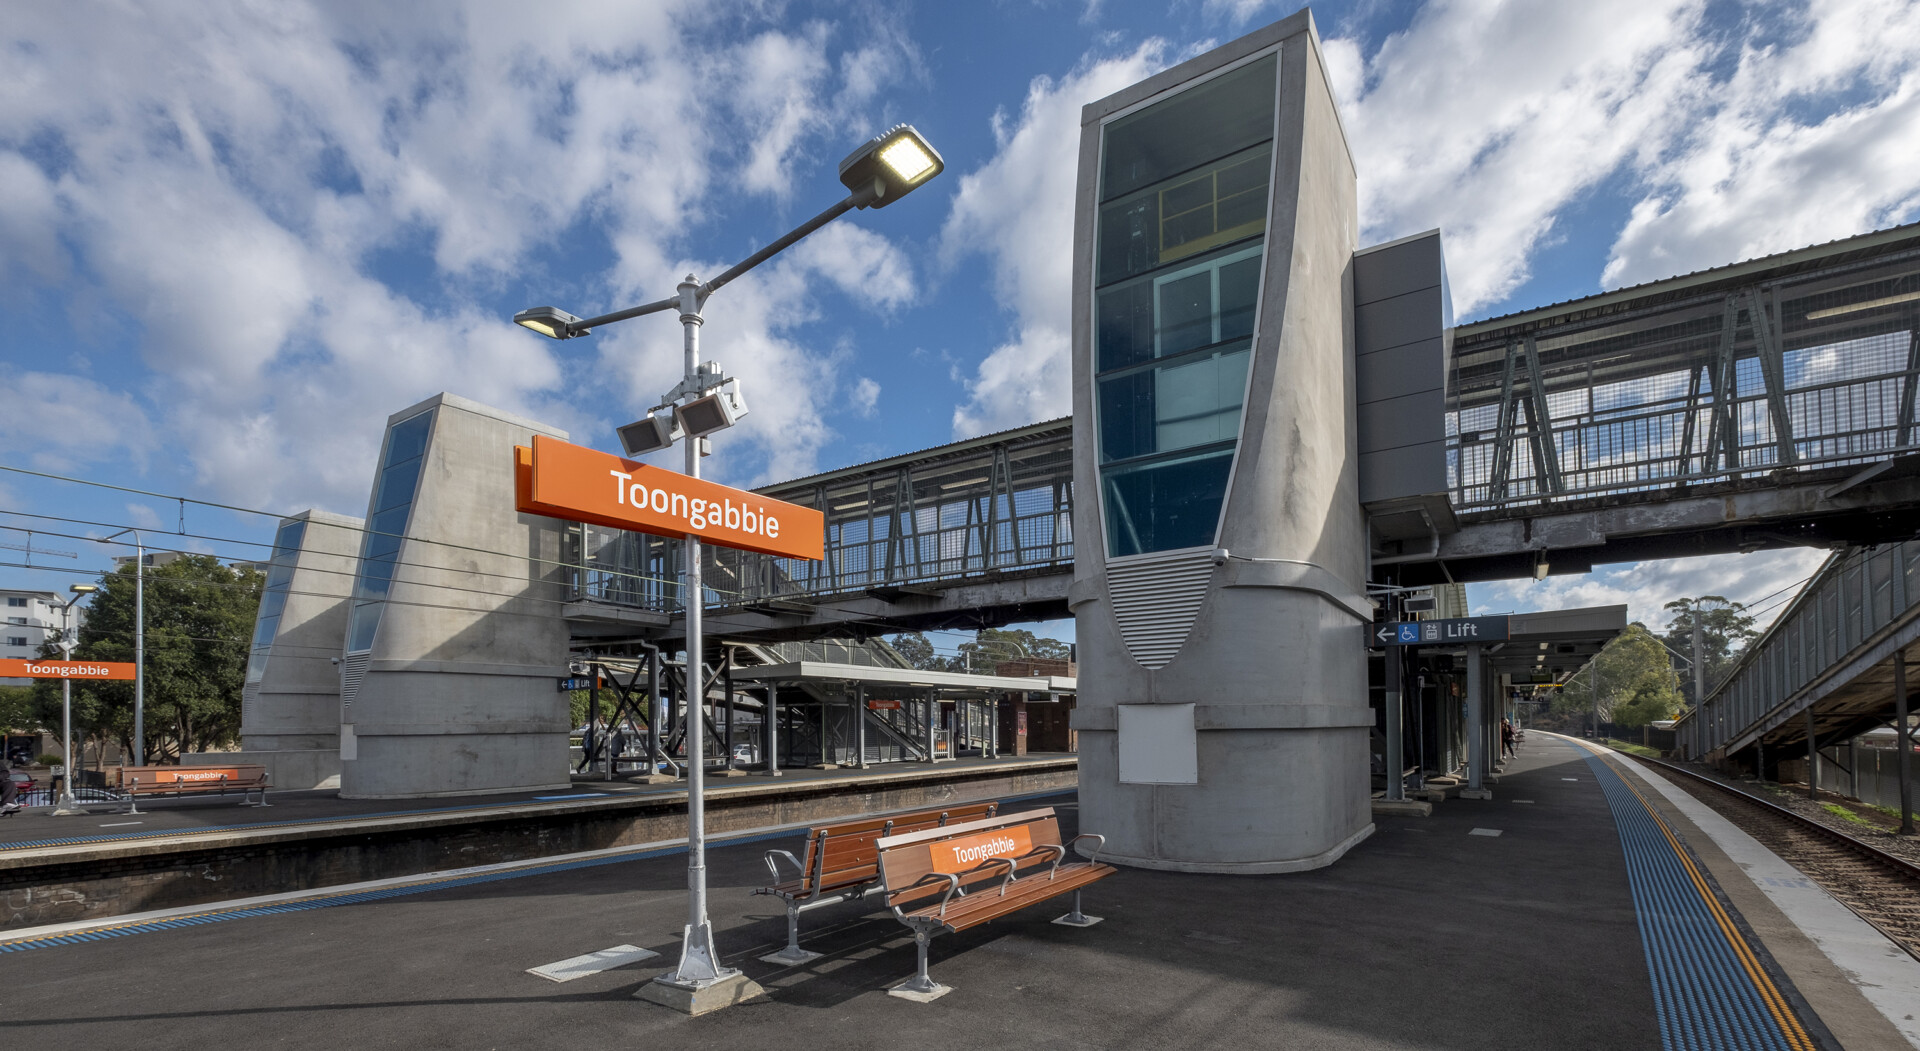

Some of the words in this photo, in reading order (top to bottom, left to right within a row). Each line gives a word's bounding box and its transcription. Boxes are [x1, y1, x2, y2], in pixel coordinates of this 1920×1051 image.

[610, 470, 779, 538] Toongabbie
[1448, 624, 1477, 637] Lift
[24, 663, 109, 677] Toongabbie
[580, 679, 590, 687] Lift
[953, 836, 1015, 863] Toongabbie
